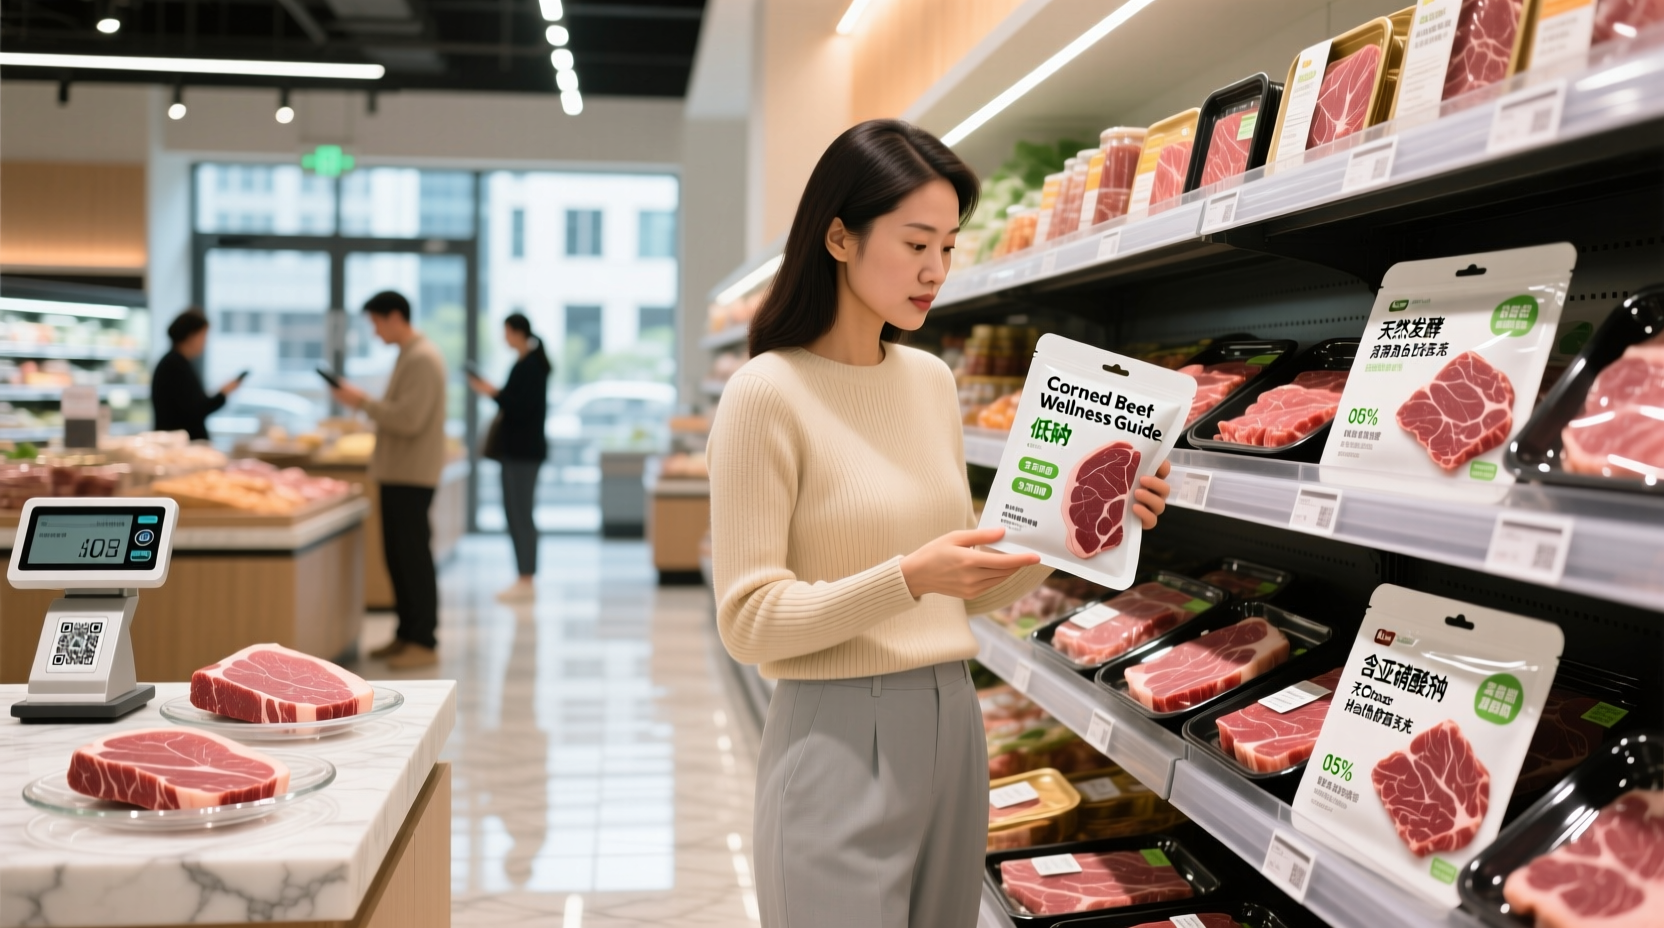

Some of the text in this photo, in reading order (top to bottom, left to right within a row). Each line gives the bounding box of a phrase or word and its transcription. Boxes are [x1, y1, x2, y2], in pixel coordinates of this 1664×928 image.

[1040, 392, 1162, 442] Wellness Guide
[1047, 376, 1155, 419] Corned Beef
[1322, 753, 1353, 782] 05%
